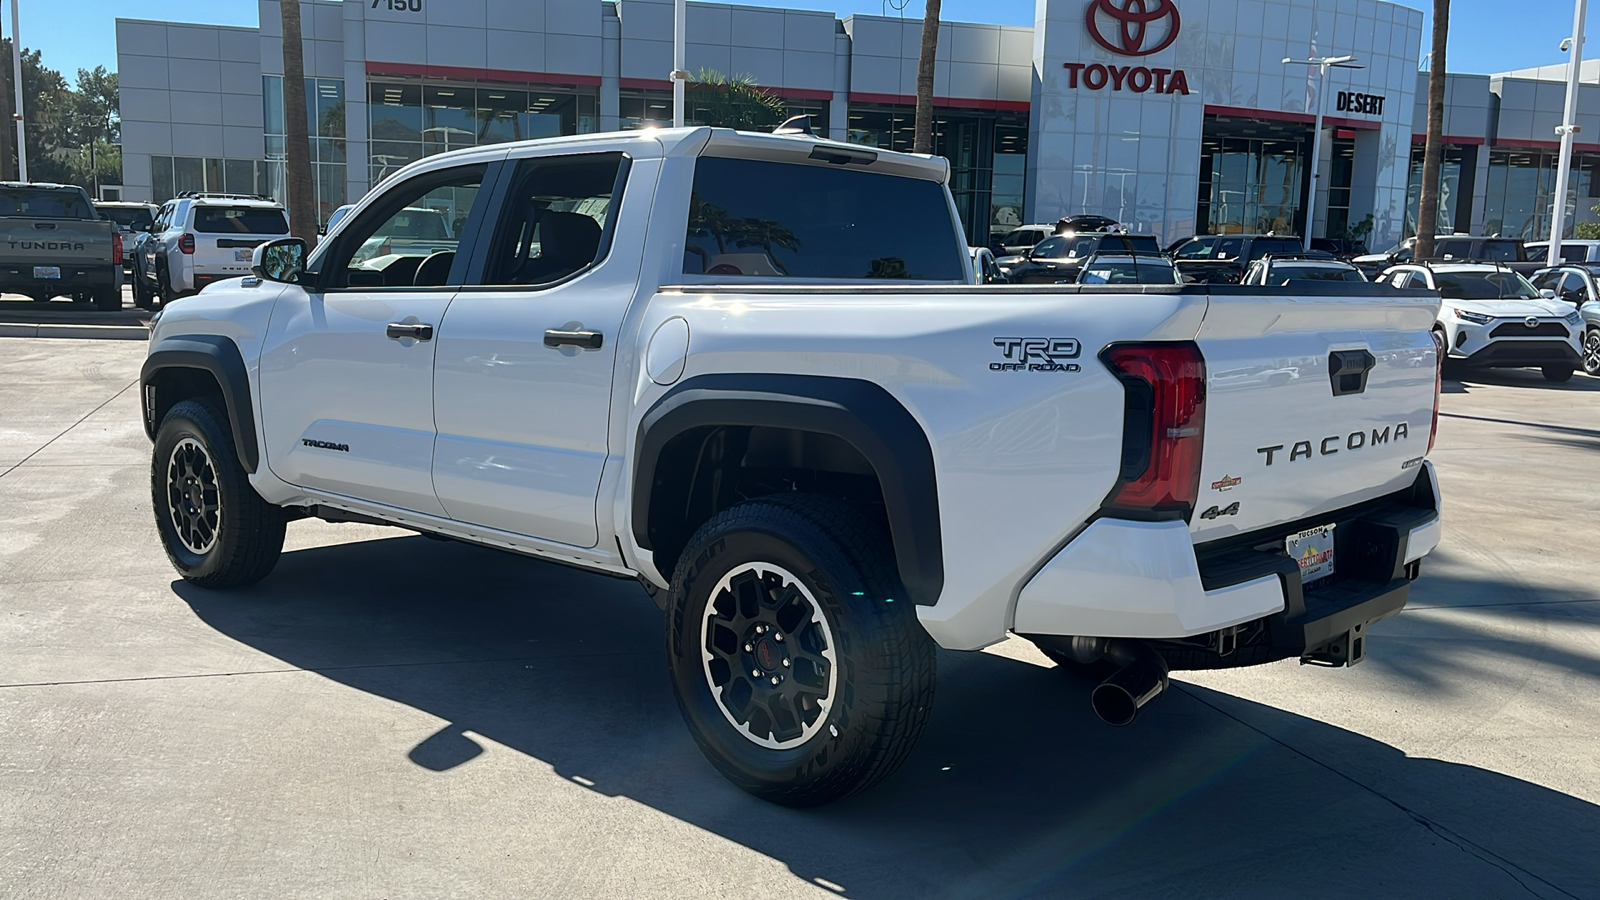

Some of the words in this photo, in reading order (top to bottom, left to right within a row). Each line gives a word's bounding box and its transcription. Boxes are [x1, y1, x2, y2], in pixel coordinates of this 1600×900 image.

[371, 0, 422, 12] 7150
[1063, 62, 1190, 95] TOYOTA
[1336, 91, 1386, 116] DESERT
[7, 241, 85, 251] TUNDRA
[993, 336, 1082, 364] TRD
[989, 362, 1026, 373] OFF
[1028, 363, 1082, 373] ROAD
[301, 438, 350, 453] TACOMA
[1256, 422, 1408, 467] TACOMA
[1298, 526, 1324, 538] TUCSON
